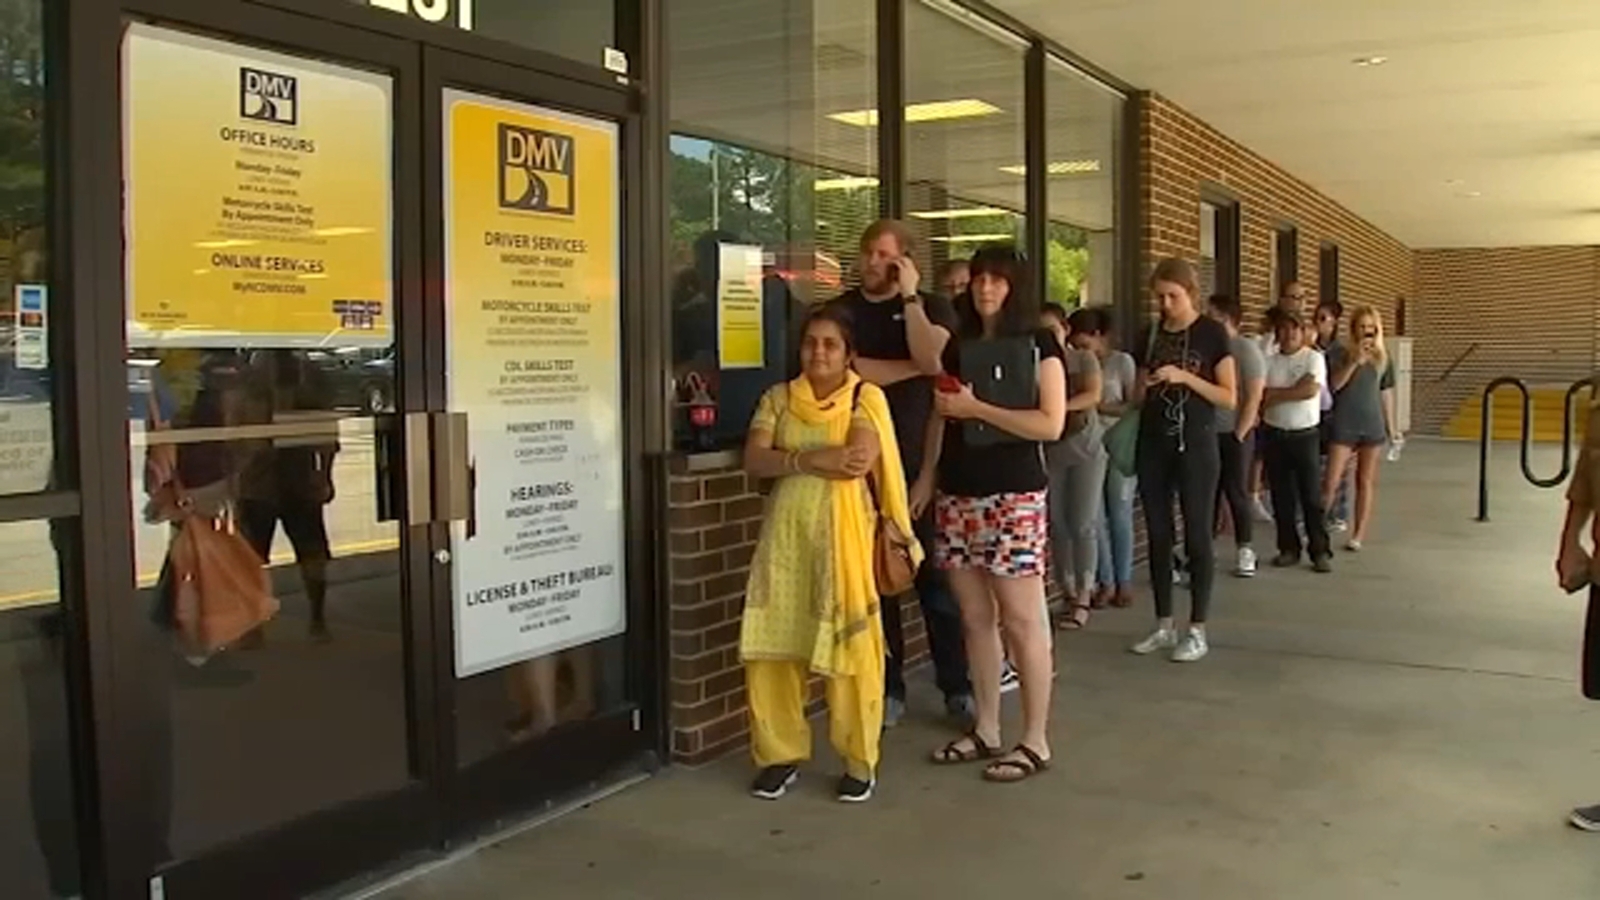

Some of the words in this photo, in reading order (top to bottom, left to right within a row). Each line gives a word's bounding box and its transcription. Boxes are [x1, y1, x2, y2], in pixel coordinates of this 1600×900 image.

[246, 73, 292, 98] DMV
[220, 127, 266, 146] OFFICE
[269, 134, 315, 153] HOURS
[507, 130, 569, 171] DMV
[223, 197, 271, 210] Motorcycle
[273, 203, 296, 212] Skills
[297, 205, 313, 214] Test
[222, 210, 233, 219] By
[236, 210, 294, 224] Appointment
[295, 217, 314, 228] Only
[485, 231, 530, 248] DRIVER
[532, 236, 588, 253] SERVICES:
[212, 253, 261, 269] ONLINE
[266, 257, 324, 273] SERVICES
[482, 300, 541, 313] MOTORCYCLE
[544, 302, 571, 313] SKILLS
[510, 315, 558, 324] APPOINTMENT
[504, 360, 523, 371] CDL
[525, 360, 553, 371] SKILLS
[554, 360, 574, 370] TEST
[549, 420, 574, 431] TYPES
[510, 481, 575, 502] HEARINGS:
[514, 537, 563, 552] APPOINTMENT
[466, 582, 517, 607] LICENSE
[520, 580, 528, 596] &
[530, 571, 566, 592] THEFT
